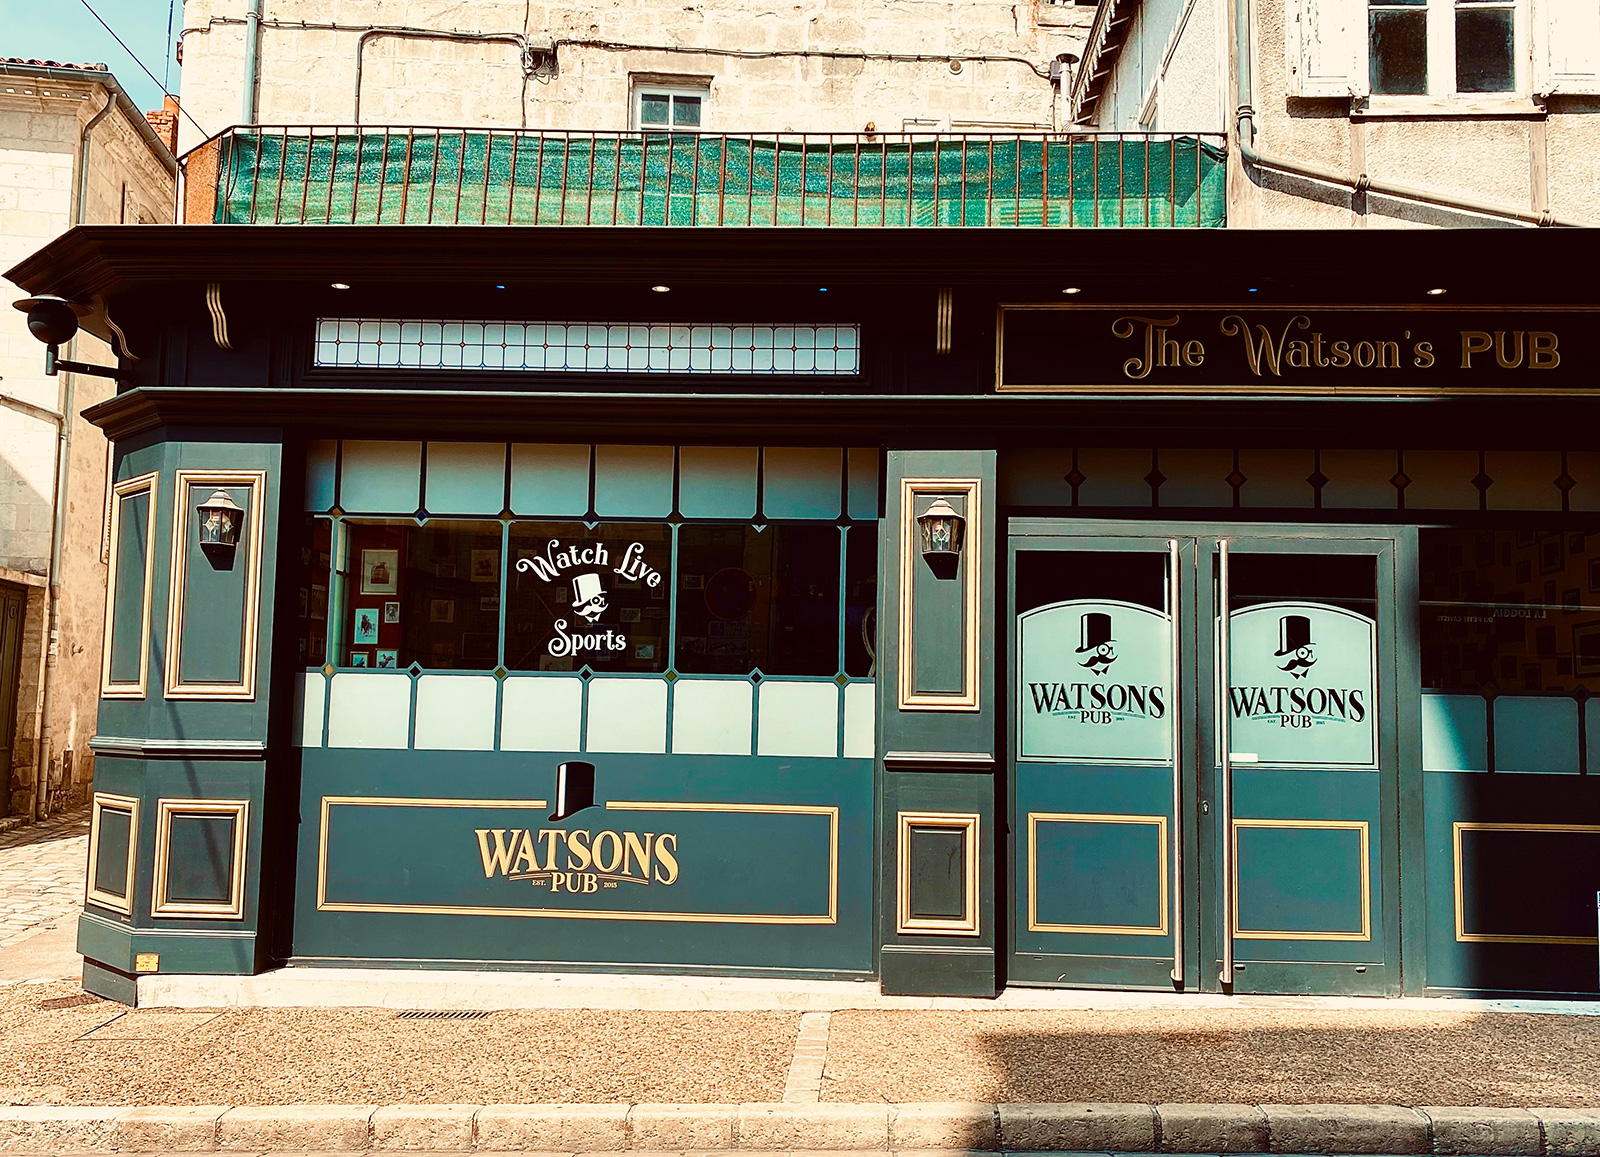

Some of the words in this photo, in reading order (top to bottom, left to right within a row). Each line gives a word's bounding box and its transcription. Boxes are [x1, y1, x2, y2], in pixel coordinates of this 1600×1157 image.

[1112, 314, 1205, 381] The
[1220, 314, 1436, 378] Watson's
[1460, 330, 1562, 370] PUB
[515, 538, 609, 582] Watch
[613, 541, 662, 588] Live
[547, 618, 627, 658] Sports
[1028, 682, 1165, 719] WATSONS
[1080, 710, 1112, 724] PUB
[1229, 686, 1365, 723] WATSONS
[1280, 714, 1312, 728] PUB
[474, 828, 680, 886] WATSONS
[550, 872, 599, 893] PUB
